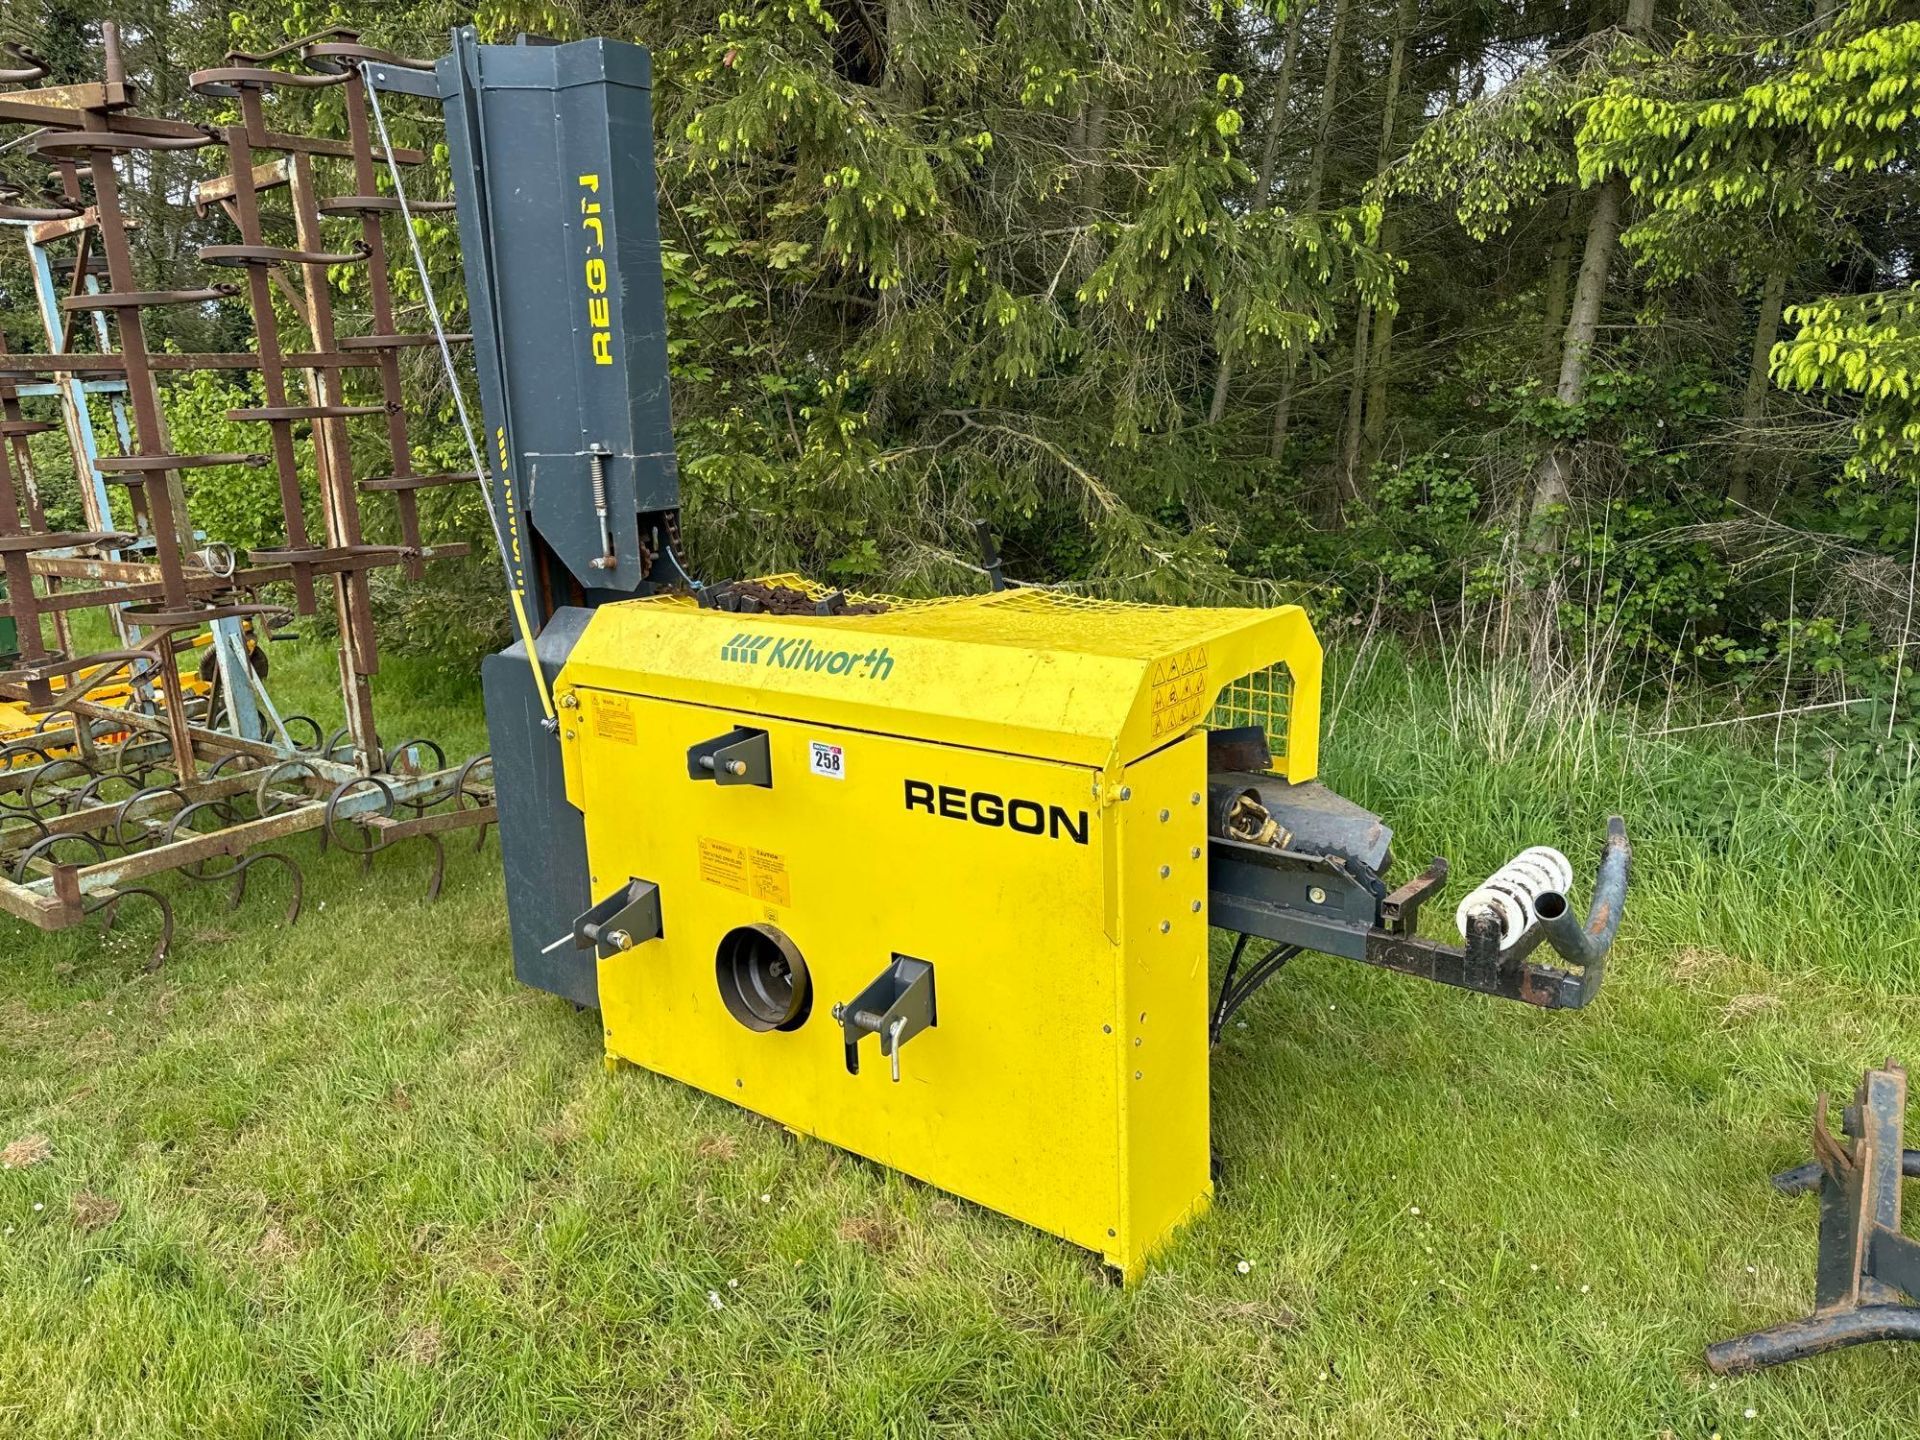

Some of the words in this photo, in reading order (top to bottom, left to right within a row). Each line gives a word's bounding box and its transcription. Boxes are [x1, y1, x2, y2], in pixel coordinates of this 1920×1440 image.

[766, 637, 895, 681] Kilworth
[815, 750, 841, 771] 258
[904, 778, 1089, 846] REGON
[756, 848, 779, 860] CAUTION
